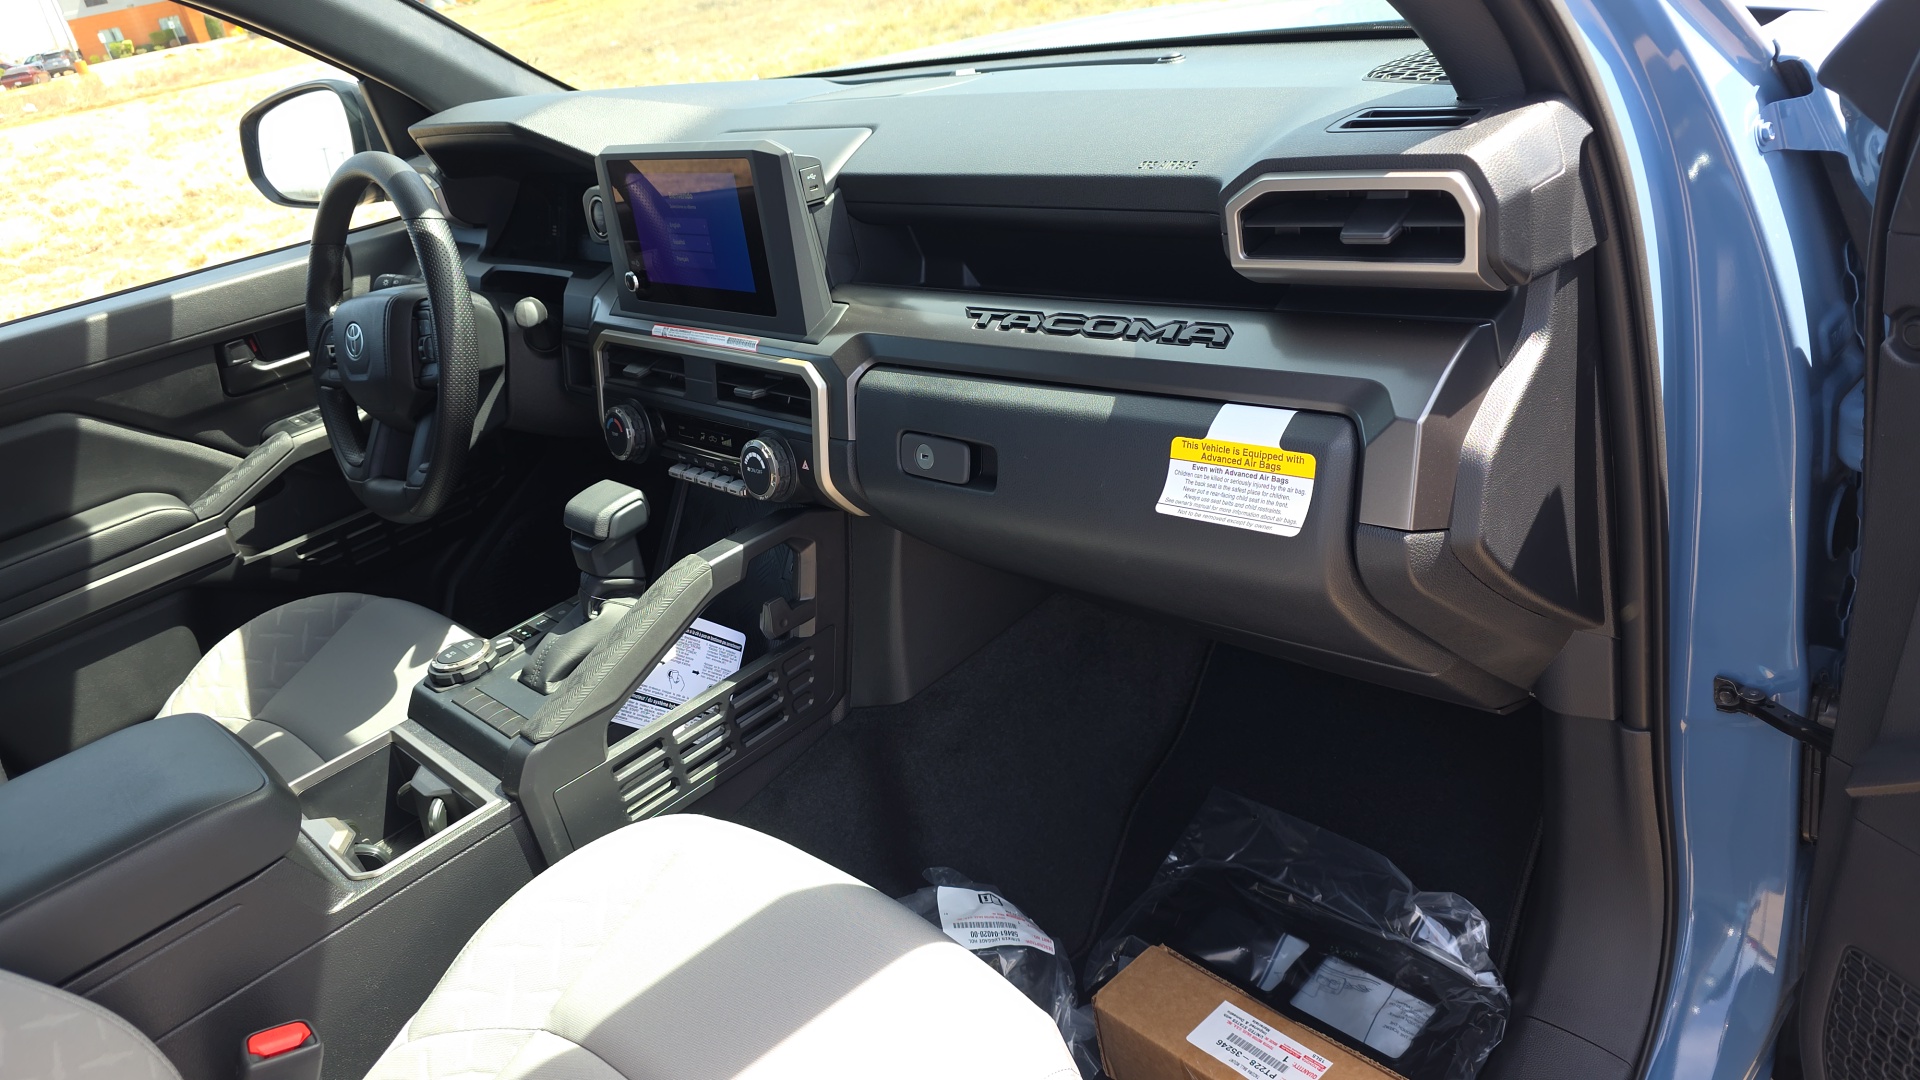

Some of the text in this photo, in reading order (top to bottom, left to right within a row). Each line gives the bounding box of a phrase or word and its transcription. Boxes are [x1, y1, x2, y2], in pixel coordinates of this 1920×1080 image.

[965, 306, 1234, 350] TACOMA
[1182, 440, 1305, 464] This Vehicle is Equipped with
[1200, 452, 1281, 472] Advanced Air Bags
[1174, 468, 1194, 477] Children
[1210, 474, 1223, 483] killed
[1229, 478, 1252, 488] seriously
[1252, 481, 1270, 490] injured
[1270, 483, 1278, 491] by
[1192, 463, 1289, 486] Even with Advanced Air Bags
[1182, 485, 1198, 493] Never
[1235, 493, 1249, 502] child
[1248, 496, 1261, 504] seat
[1265, 498, 1275, 506] the
[1185, 478, 1194, 486] The
[1206, 482, 1218, 490] seat
[1222, 484, 1232, 492] the
[1231, 486, 1247, 494] safest
[1246, 488, 1261, 497] place
[1183, 493, 1201, 502] Always
[1221, 499, 1234, 507] belts
[1244, 503, 1258, 511] child
[1192, 502, 1212, 510] manual
[1218, 506, 1232, 514] more
[1231, 508, 1260, 518] information
[1259, 513, 1276, 521] about
[1202, 514, 1227, 523] removed
[1226, 518, 1246, 526] except
[1245, 520, 1254, 528] by
[1232, 1018, 1248, 1030] STATES
[1247, 1028, 1264, 1039] UNITED
[1215, 1039, 1243, 1058] 35246
[1249, 1059, 1278, 1080] PT228
[1292, 1061, 1318, 1080] QUANTITY:
